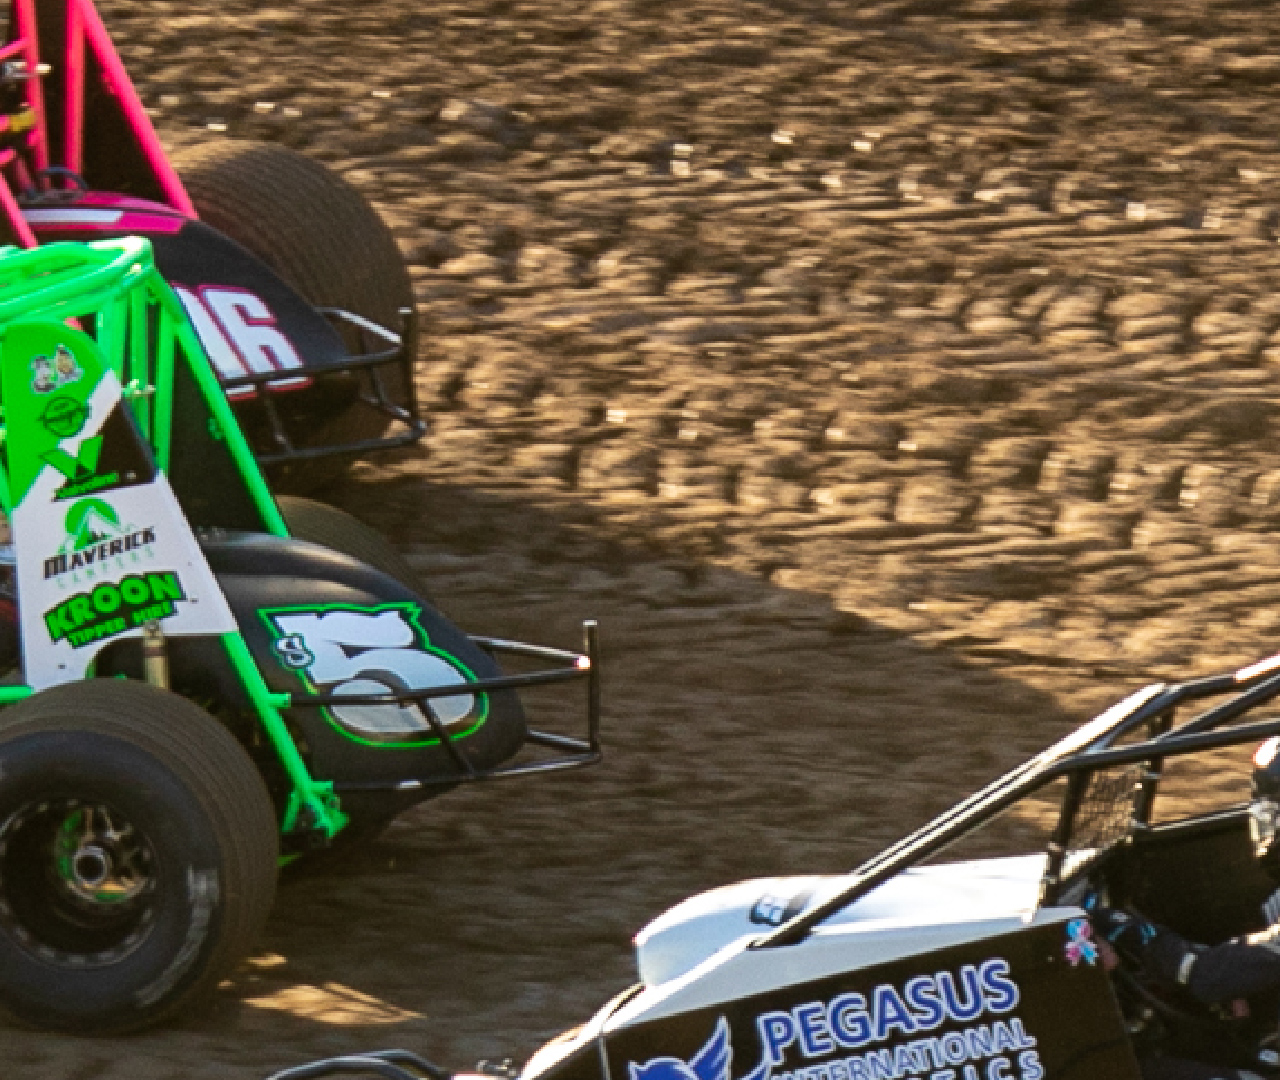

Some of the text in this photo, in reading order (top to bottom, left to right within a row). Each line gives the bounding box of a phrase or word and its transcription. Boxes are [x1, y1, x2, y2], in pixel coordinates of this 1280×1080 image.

[43, 526, 156, 579] MAVERICK
[44, 571, 186, 642] KROON
[265, 606, 483, 741] 5
[757, 957, 1020, 1065] PEGASUS
